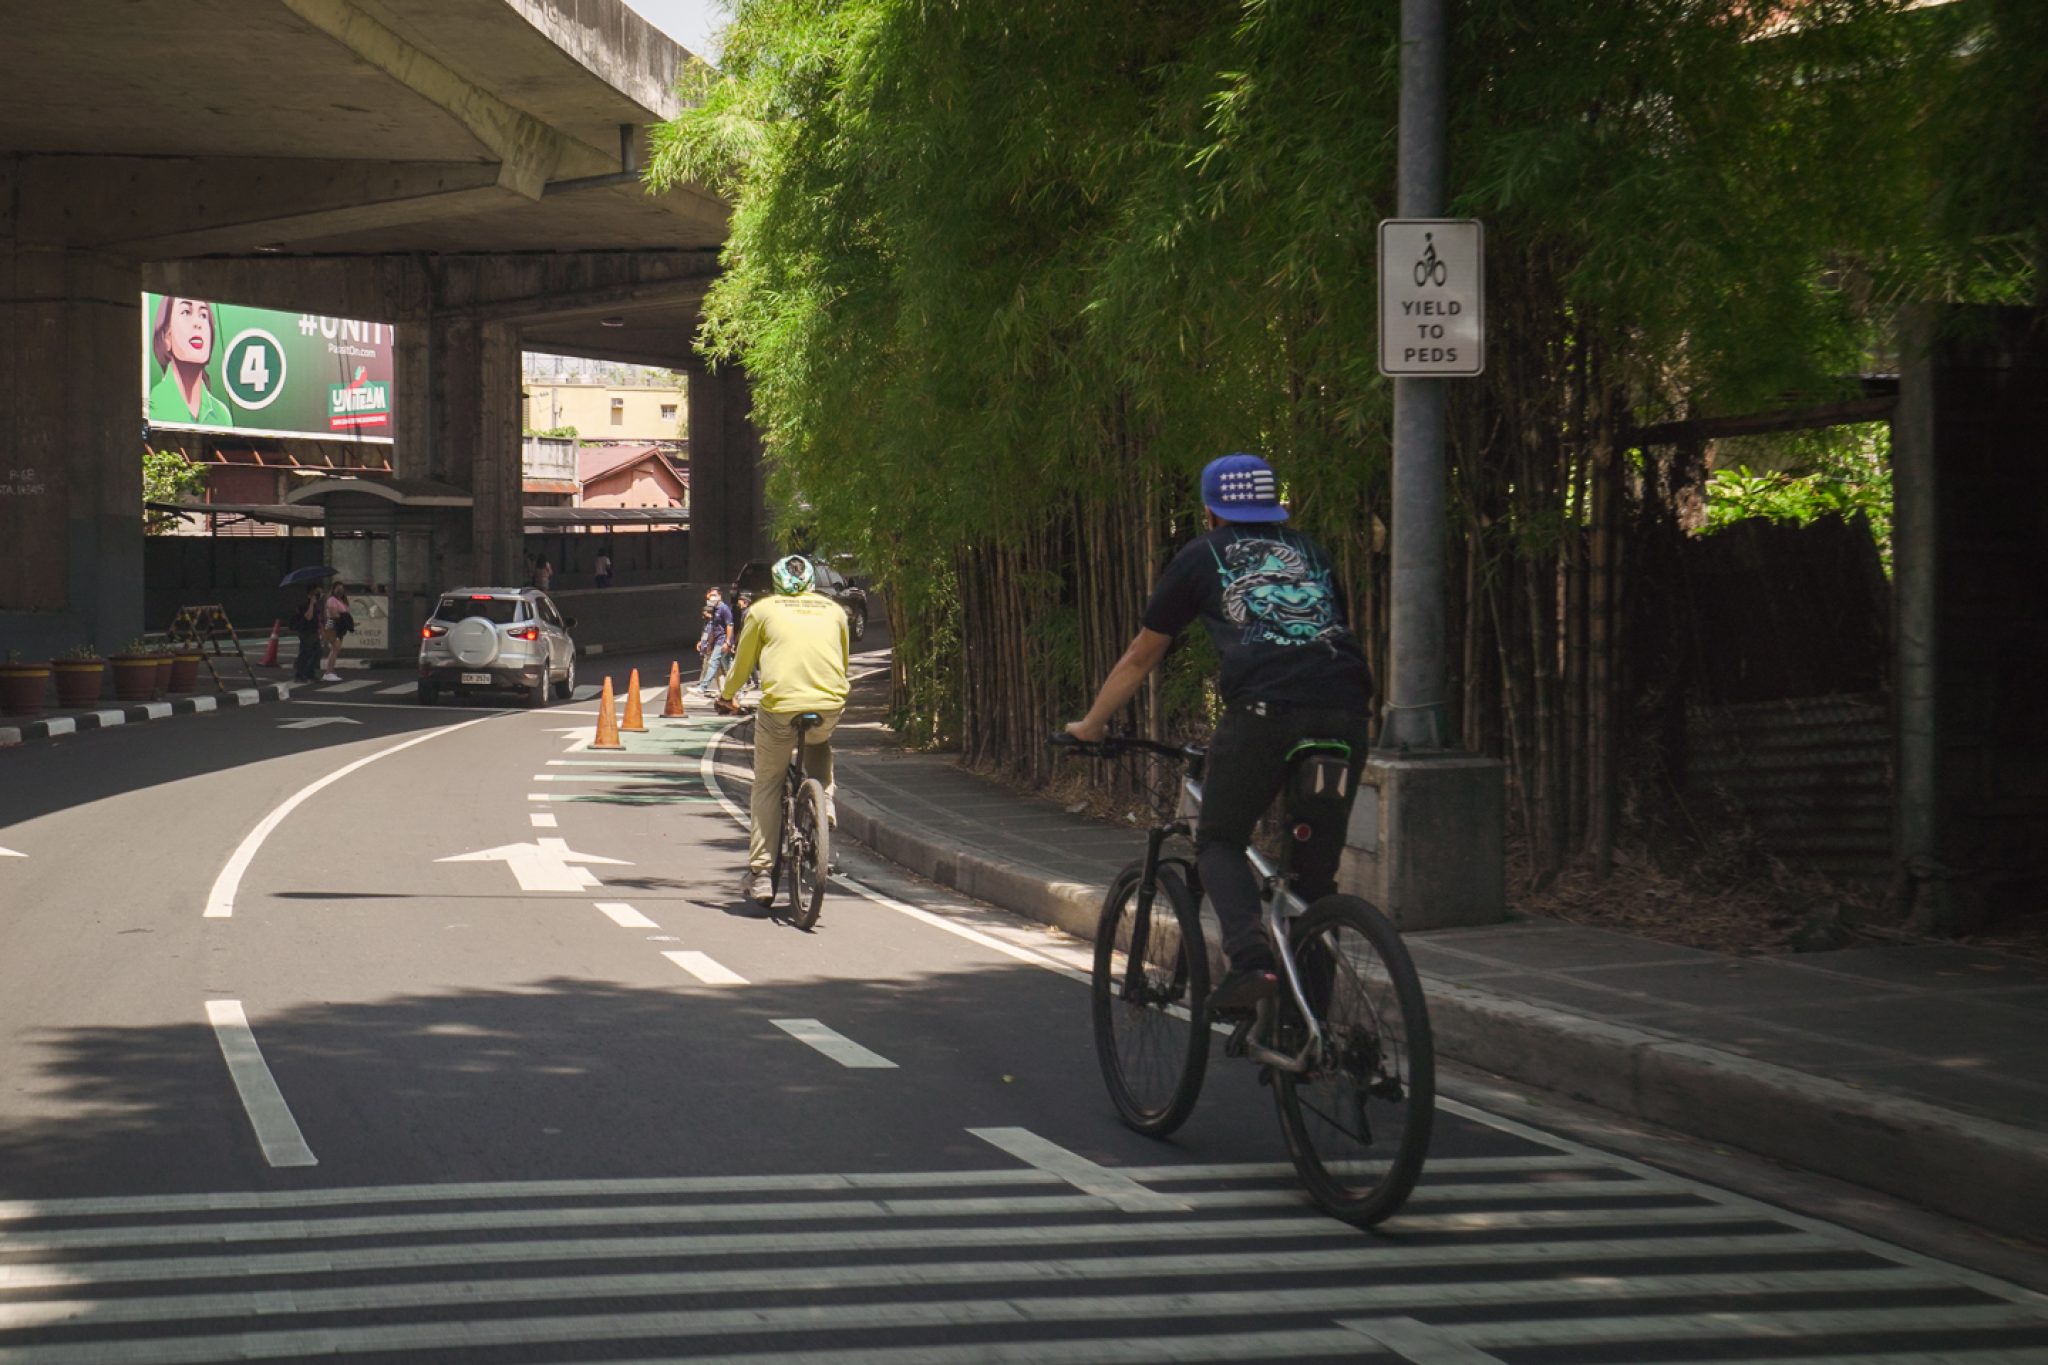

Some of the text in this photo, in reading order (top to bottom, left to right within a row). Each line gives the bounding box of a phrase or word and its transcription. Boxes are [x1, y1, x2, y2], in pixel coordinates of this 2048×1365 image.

[1402, 301, 1462, 316] YIELD
[1417, 324, 1445, 339] TO
[1404, 348, 1458, 362] PEDS
[240, 345, 270, 392] 4
